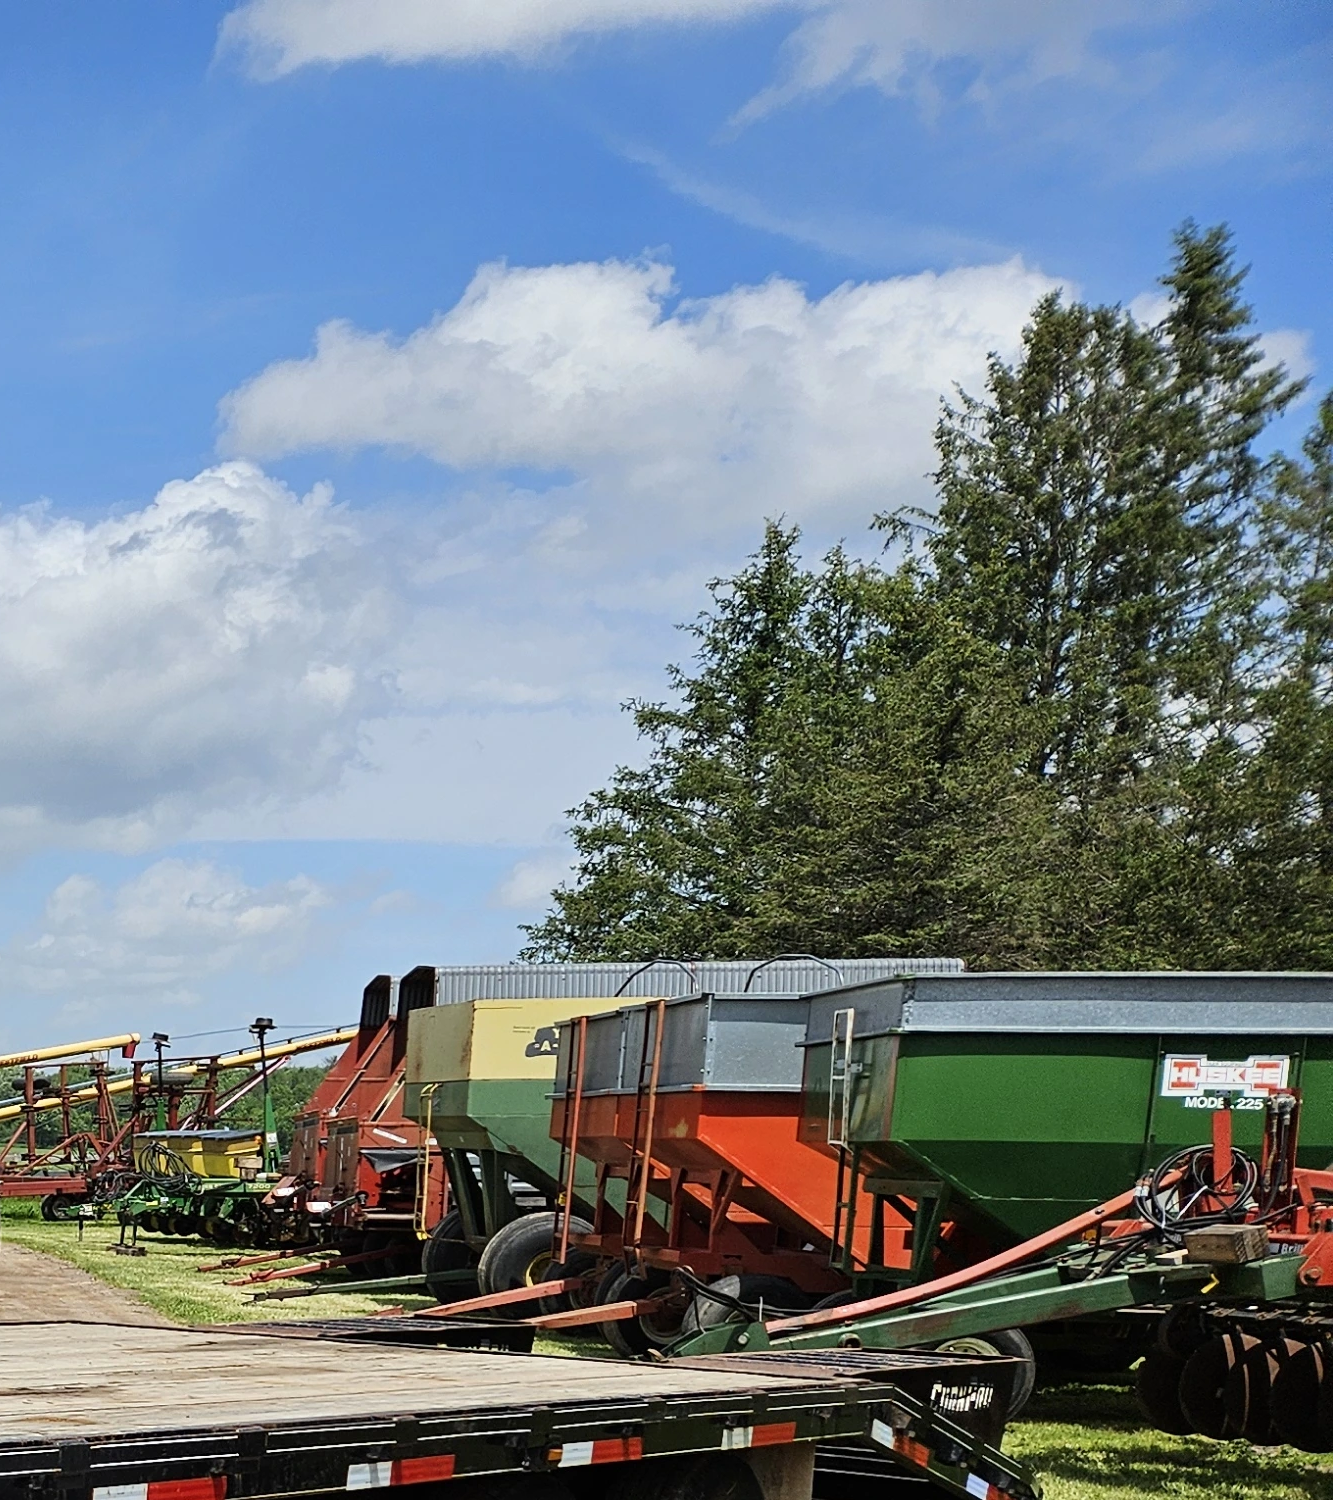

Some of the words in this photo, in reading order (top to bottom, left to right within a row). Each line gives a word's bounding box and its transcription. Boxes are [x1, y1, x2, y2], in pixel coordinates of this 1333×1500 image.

[1172, 1063, 1281, 1086] HUSKEE
[1184, 1097, 1234, 1110] MODE
[1234, 1098, 1265, 1110] 225
